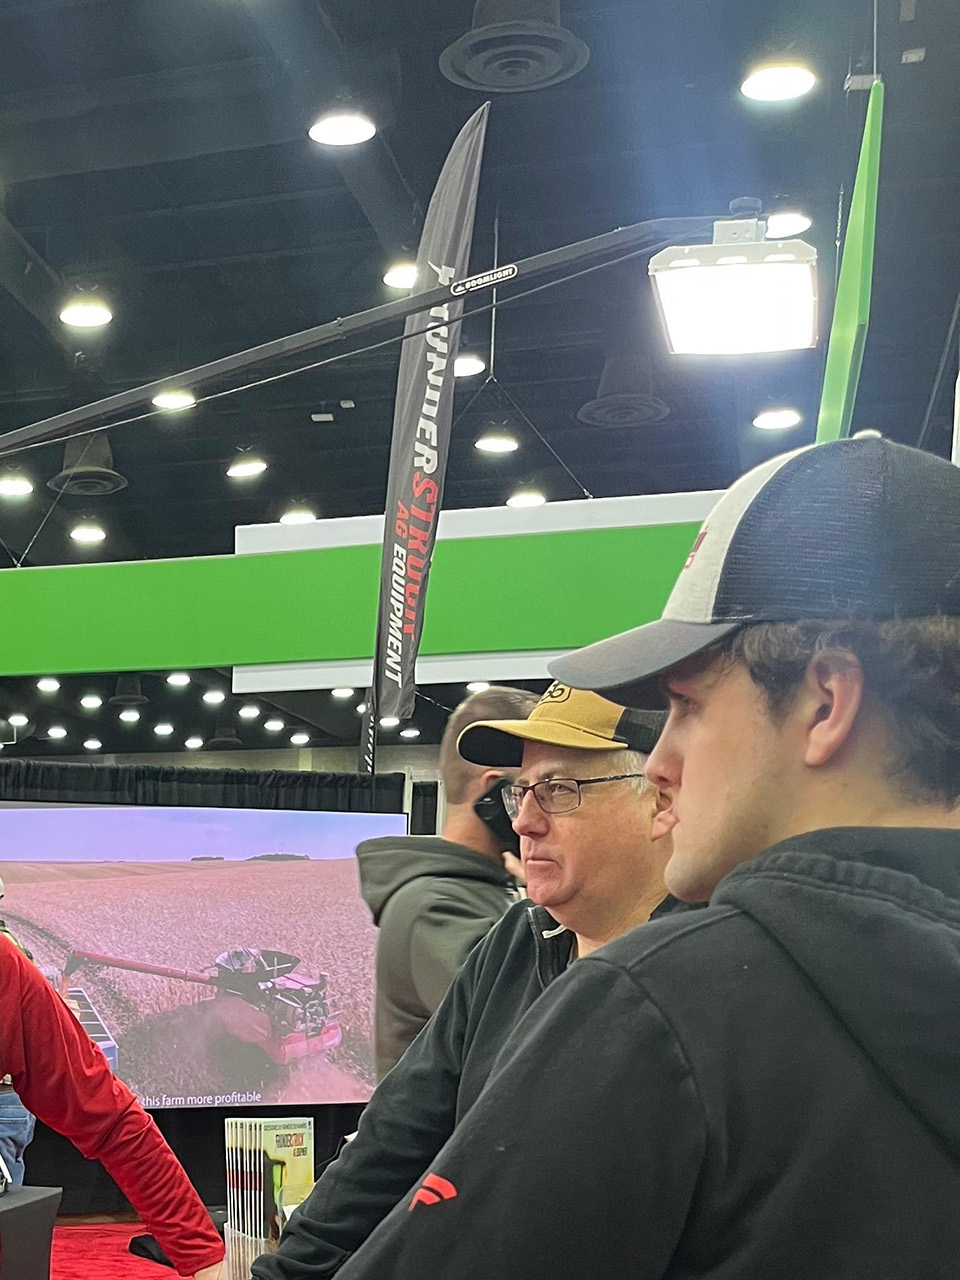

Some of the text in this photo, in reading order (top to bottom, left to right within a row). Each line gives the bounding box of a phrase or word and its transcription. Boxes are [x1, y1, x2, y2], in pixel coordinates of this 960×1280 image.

[384, 542, 407, 689] EQUIPMENT
[162, 1094, 185, 1106] farm
[187, 1095, 213, 1105] more
[214, 1091, 262, 1107] profitable
